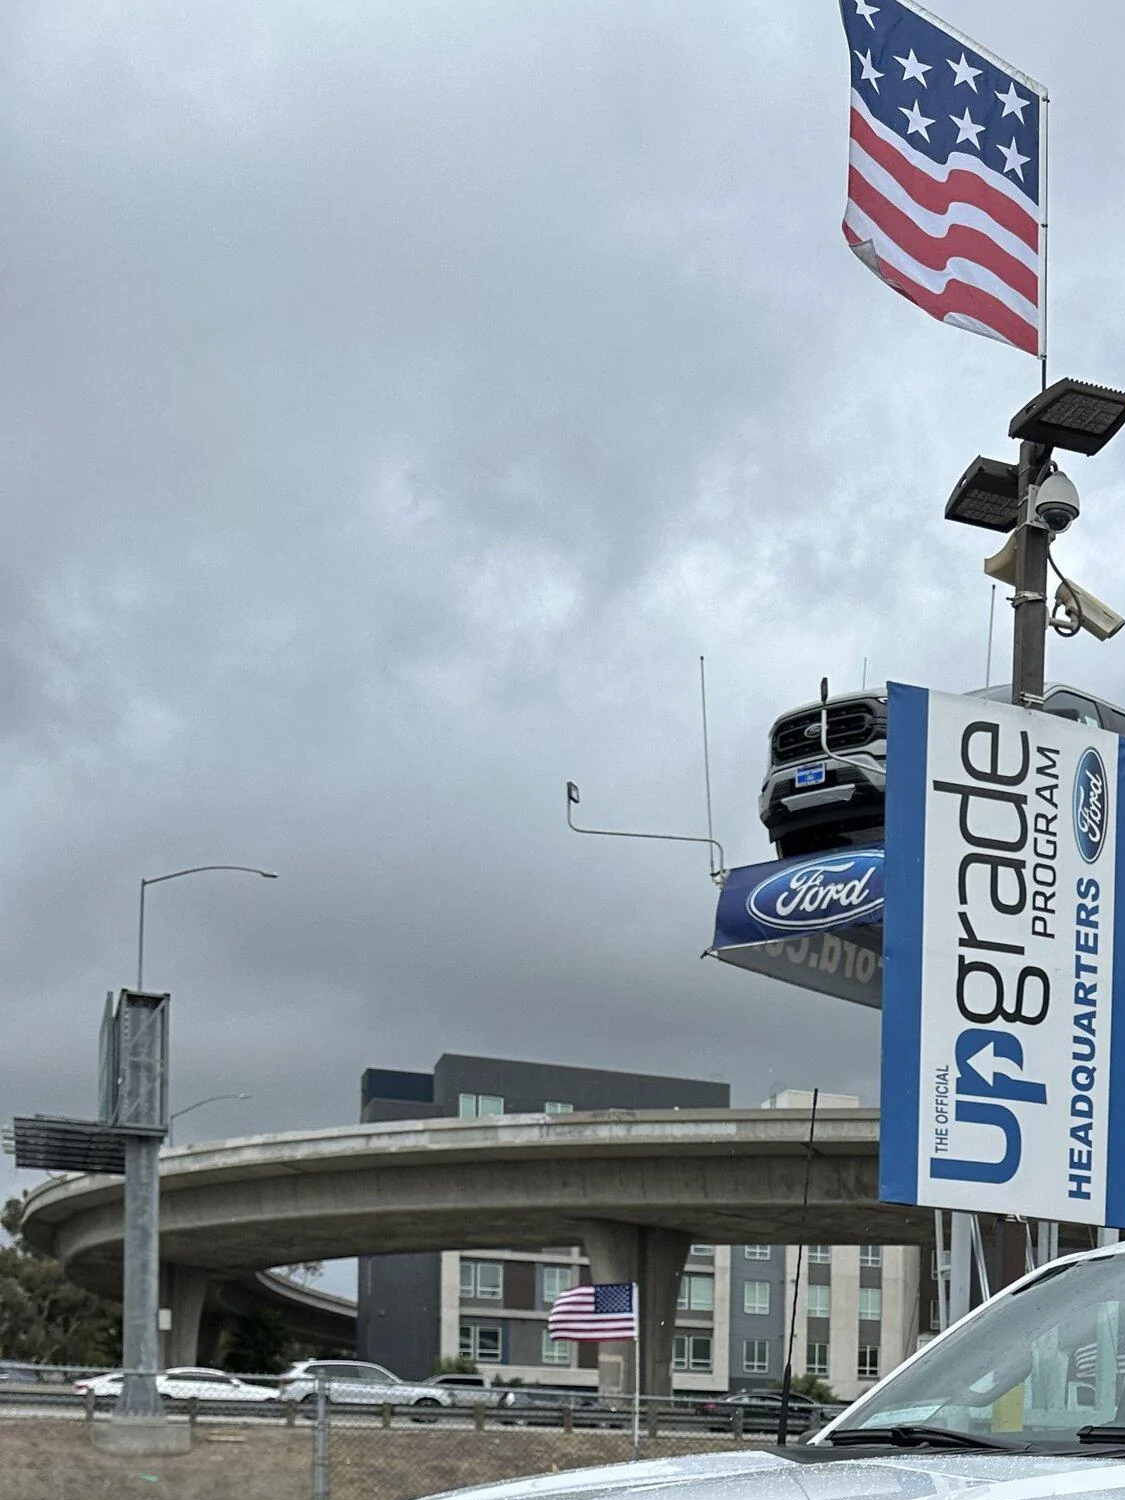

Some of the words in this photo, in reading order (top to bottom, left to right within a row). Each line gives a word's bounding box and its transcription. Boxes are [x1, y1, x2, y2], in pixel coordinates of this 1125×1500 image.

[1078, 769, 1104, 844] Ford
[1031, 745, 1061, 939] PROGRAM
[775, 861, 876, 916] Ford
[1067, 877, 1101, 1200] HEADQUARTERS
[934, 1064, 949, 1124] OFFICIAL
[934, 1126, 949, 1153] THE
